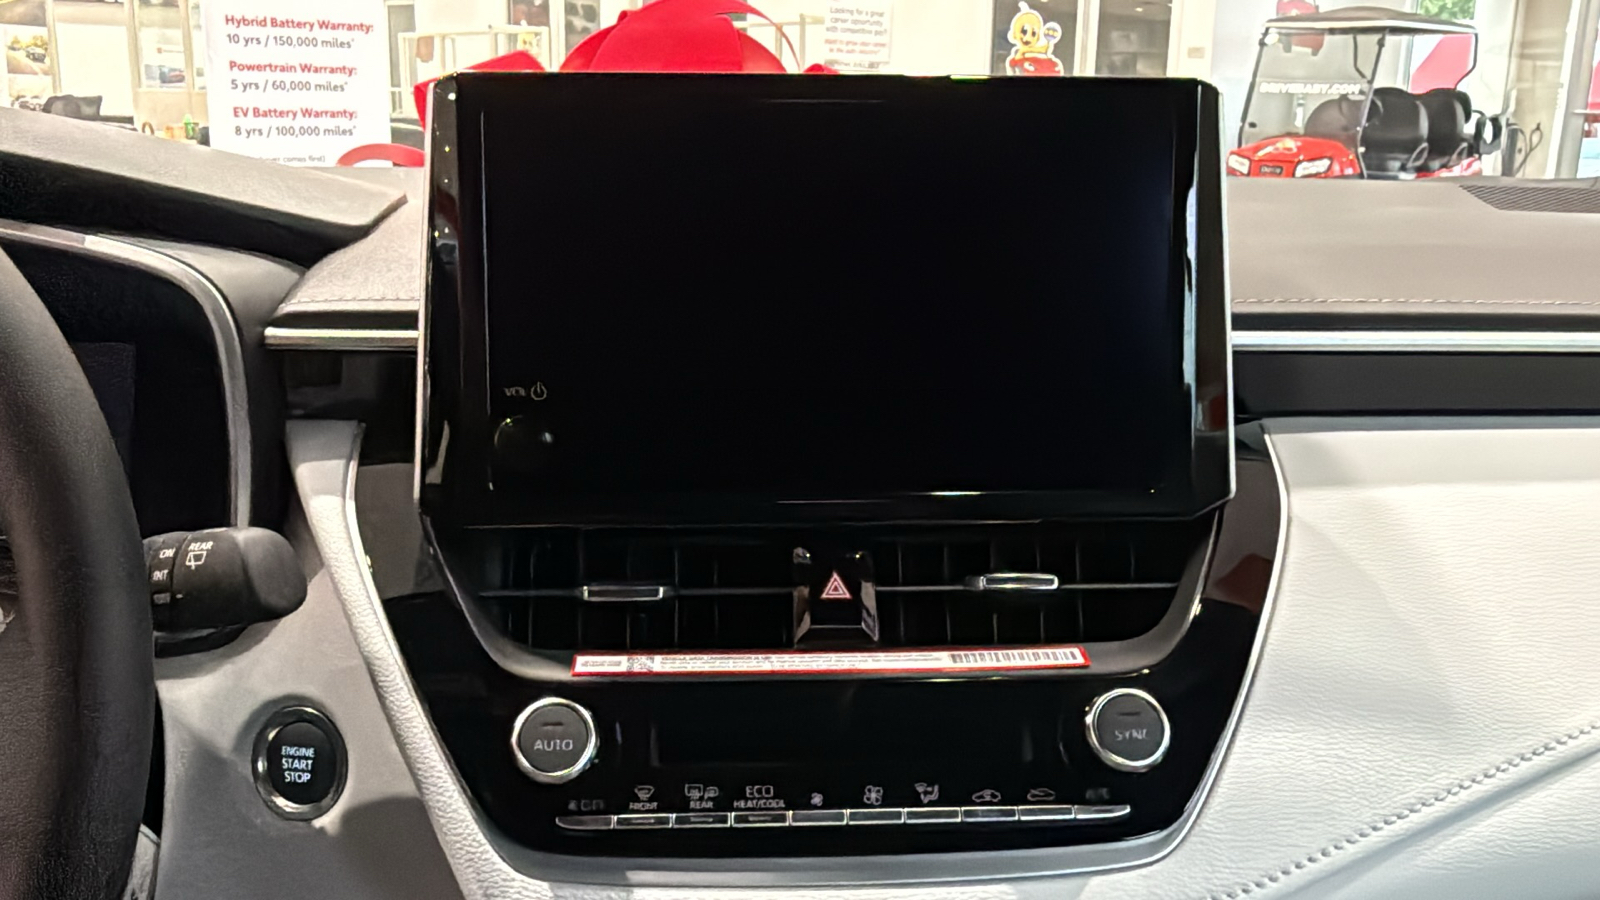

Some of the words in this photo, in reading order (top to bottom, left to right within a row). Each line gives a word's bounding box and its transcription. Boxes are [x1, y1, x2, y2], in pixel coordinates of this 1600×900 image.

[225, 14, 267, 29] Hybrid
[270, 17, 315, 32] Battery
[317, 19, 374, 35] Warranty:
[226, 33, 240, 44] 10
[243, 36, 261, 47] yrs
[264, 35, 270, 48] /
[273, 36, 318, 48] 150,000
[229, 60, 297, 73] Powertrain
[299, 63, 358, 77] Warranty:
[231, 78, 238, 90] 5
[241, 81, 260, 93] yrs
[263, 79, 268, 93] /
[271, 80, 311, 93] 60,000
[233, 106, 249, 118] EV
[252, 107, 298, 121] Battery
[300, 107, 358, 121] Warranty:
[235, 125, 242, 136] 8
[245, 127, 263, 139] yrs
[266, 125, 272, 138] /
[275, 126, 320, 138] 100,000
[159, 546, 176, 559] ON
[188, 541, 213, 551] REAR
[533, 738, 574, 751] AUTO
[281, 745, 315, 758] ENGINE
[282, 757, 313, 771] START
[284, 771, 311, 783] STOP
[745, 785, 774, 798] ECO
[689, 801, 714, 809] REAR
[733, 799, 786, 809] HEAT/COOL
